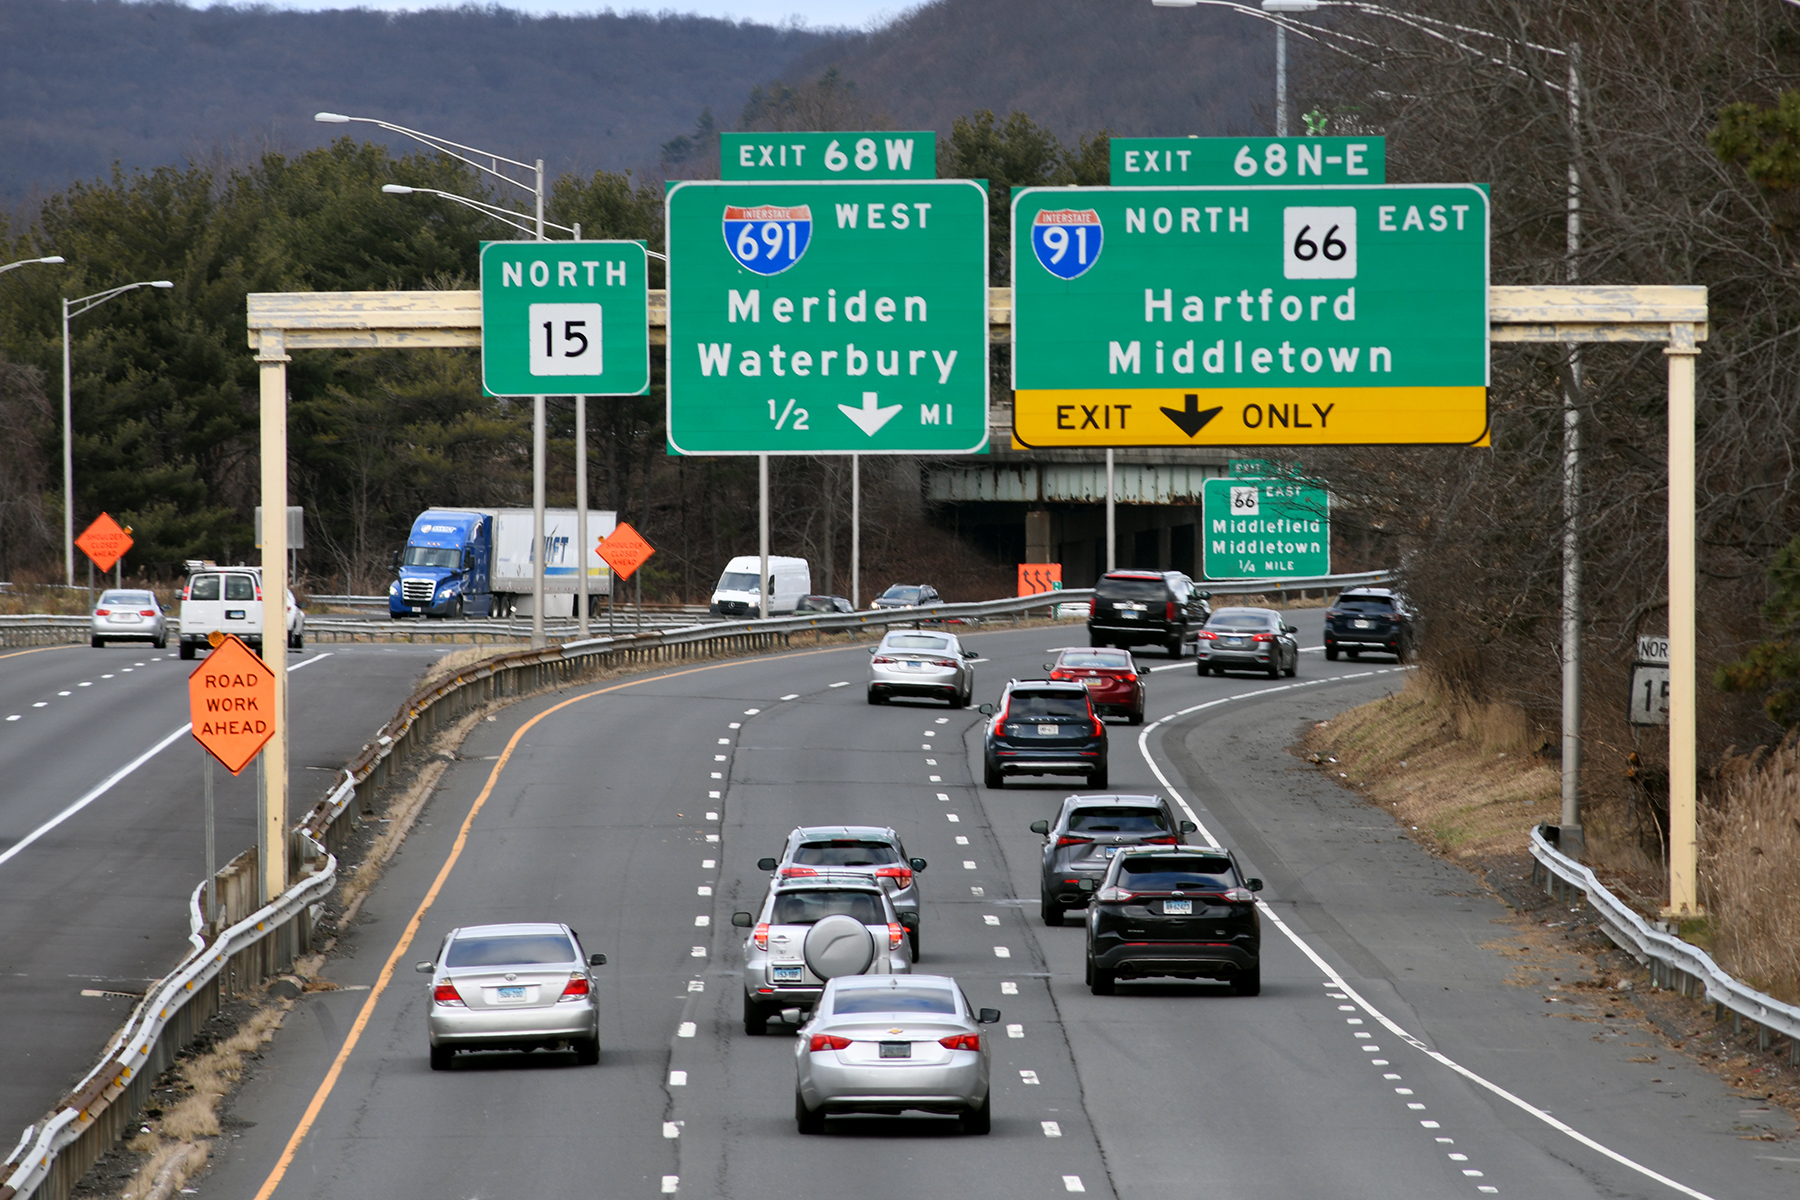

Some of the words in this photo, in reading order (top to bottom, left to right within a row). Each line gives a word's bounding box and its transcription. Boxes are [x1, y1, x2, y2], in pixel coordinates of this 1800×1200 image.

[740, 145, 805, 167] EXIT
[825, 138, 914, 171] 68W
[1125, 151, 1191, 172] EXIT
[1234, 144, 1368, 177] 68N-E
[743, 209, 791, 219] INTERSTATE
[836, 203, 931, 229] WEST
[1042, 213, 1091, 223] INTERSTATE
[1126, 207, 1249, 233] NORTH
[1379, 205, 1469, 231] EAST
[737, 221, 796, 261] 691
[1043, 226, 1086, 265] 91
[1293, 225, 1347, 261] 66
[502, 260, 626, 287] NORTH
[728, 289, 927, 322] Meriden
[1144, 287, 1356, 322] Hartford
[543, 321, 588, 358] 15
[698, 342, 957, 384] Waterbury
[1108, 340, 1392, 374] Middletown
[921, 404, 953, 425] MI
[1057, 405, 1132, 430] EXIT
[1242, 403, 1335, 429] ONLY
[1234, 491, 1255, 508] 66
[1266, 486, 1301, 497] EAST
[1212, 519, 1320, 533] Middlefield
[86, 533, 123, 541] SHOULDER
[91, 541, 119, 549] CLOSED
[605, 541, 643, 549] SHOULDER
[610, 550, 638, 558] CLOSED
[1212, 540, 1321, 554] Middletown
[612, 558, 637, 566] AHEAD
[1265, 561, 1294, 571] MILE
[1641, 641, 1669, 658] NOR
[205, 673, 258, 688] ROAD
[206, 697, 259, 712] WORK
[201, 720, 267, 735] AHEAD
